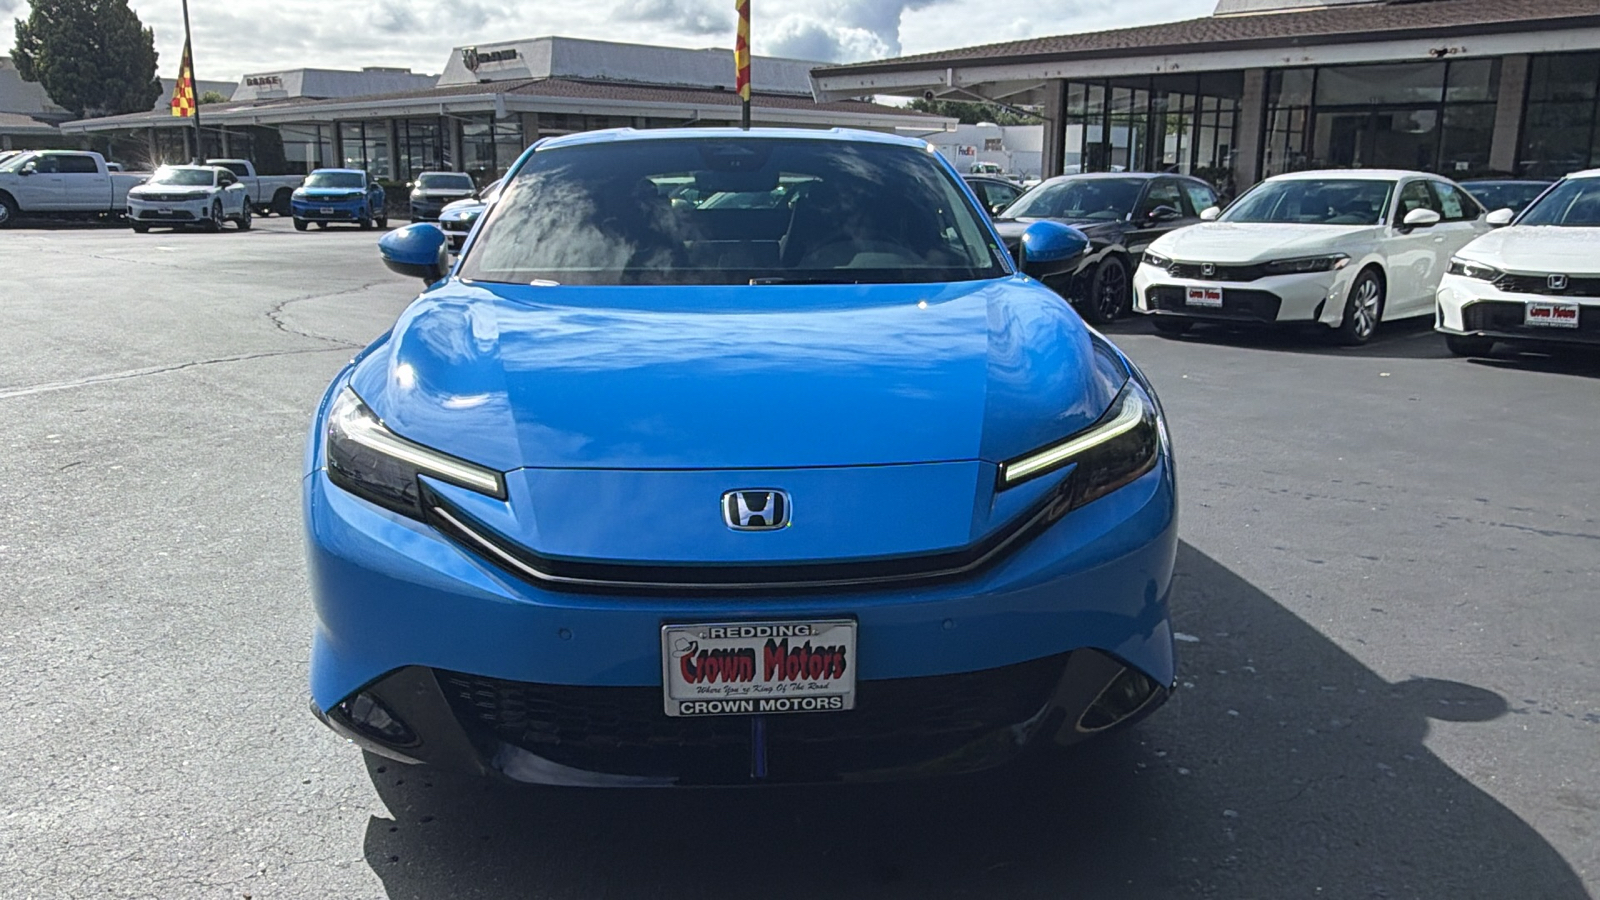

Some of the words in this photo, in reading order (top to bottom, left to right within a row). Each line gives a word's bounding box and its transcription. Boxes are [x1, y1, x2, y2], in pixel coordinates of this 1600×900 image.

[1530, 305, 1551, 318] Crown
[1552, 305, 1576, 319] Motors
[711, 625, 810, 638] REDDING
[680, 640, 756, 684] Crown
[763, 638, 847, 682] Motors
[696, 686, 721, 694] Where
[752, 684, 773, 694] King
[776, 683, 788, 693] Of
[790, 682, 804, 691] The
[808, 681, 830, 690] Road
[680, 700, 754, 714] CROWN
[759, 696, 842, 712] MOTORS
